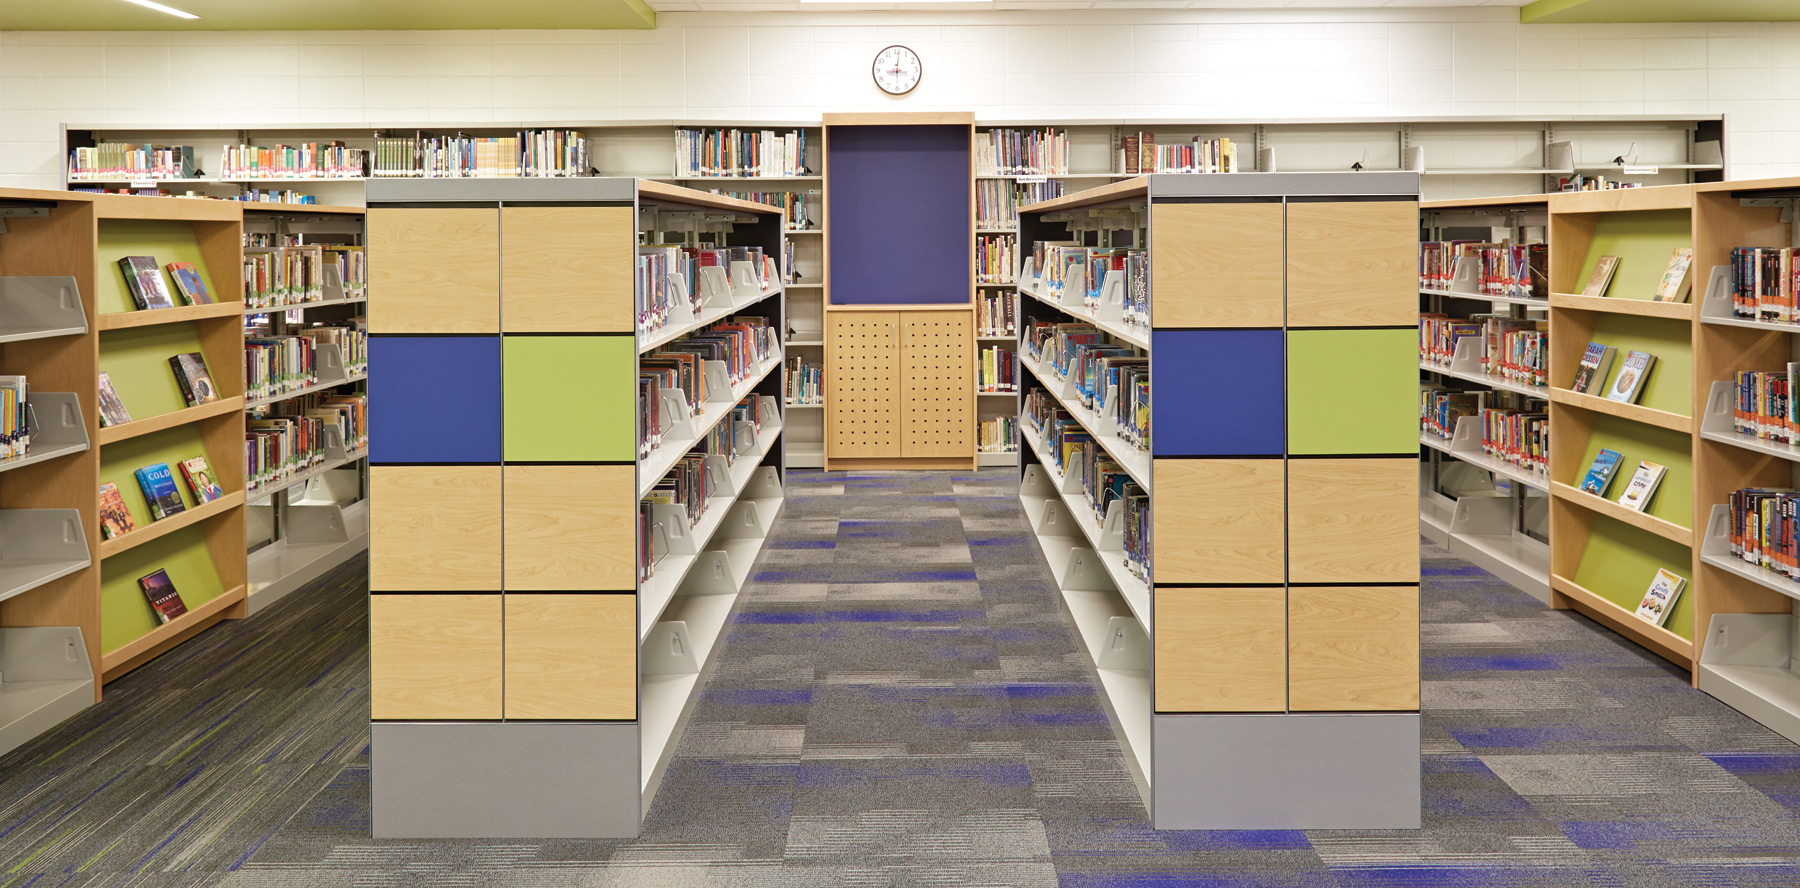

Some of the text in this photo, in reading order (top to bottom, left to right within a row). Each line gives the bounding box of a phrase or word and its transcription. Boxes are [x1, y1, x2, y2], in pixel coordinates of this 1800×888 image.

[1586, 345, 1604, 355] SARAH
[1582, 353, 1599, 364] DESSEN
[148, 469, 170, 480] COLD
[1655, 584, 1668, 594] Candy
[155, 592, 178, 605] TITANIC
